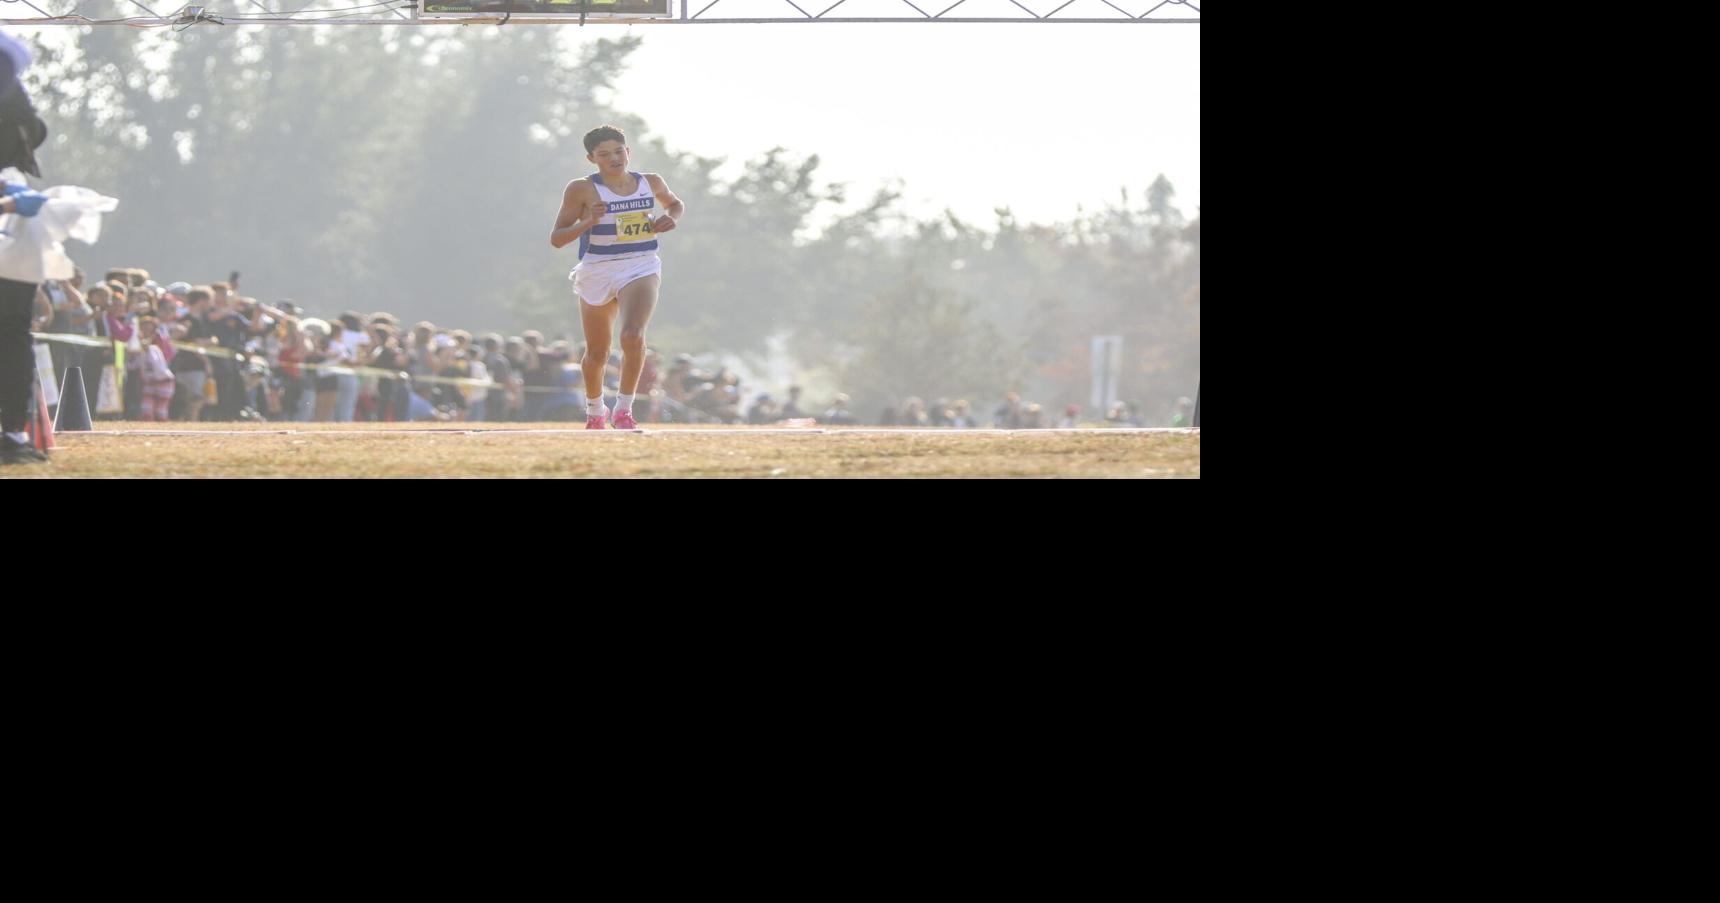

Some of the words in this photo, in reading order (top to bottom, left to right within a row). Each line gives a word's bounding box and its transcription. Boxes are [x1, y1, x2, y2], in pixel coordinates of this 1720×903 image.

[610, 203, 629, 211] DANA
[629, 200, 650, 209] HILLS
[623, 222, 651, 236] 474
